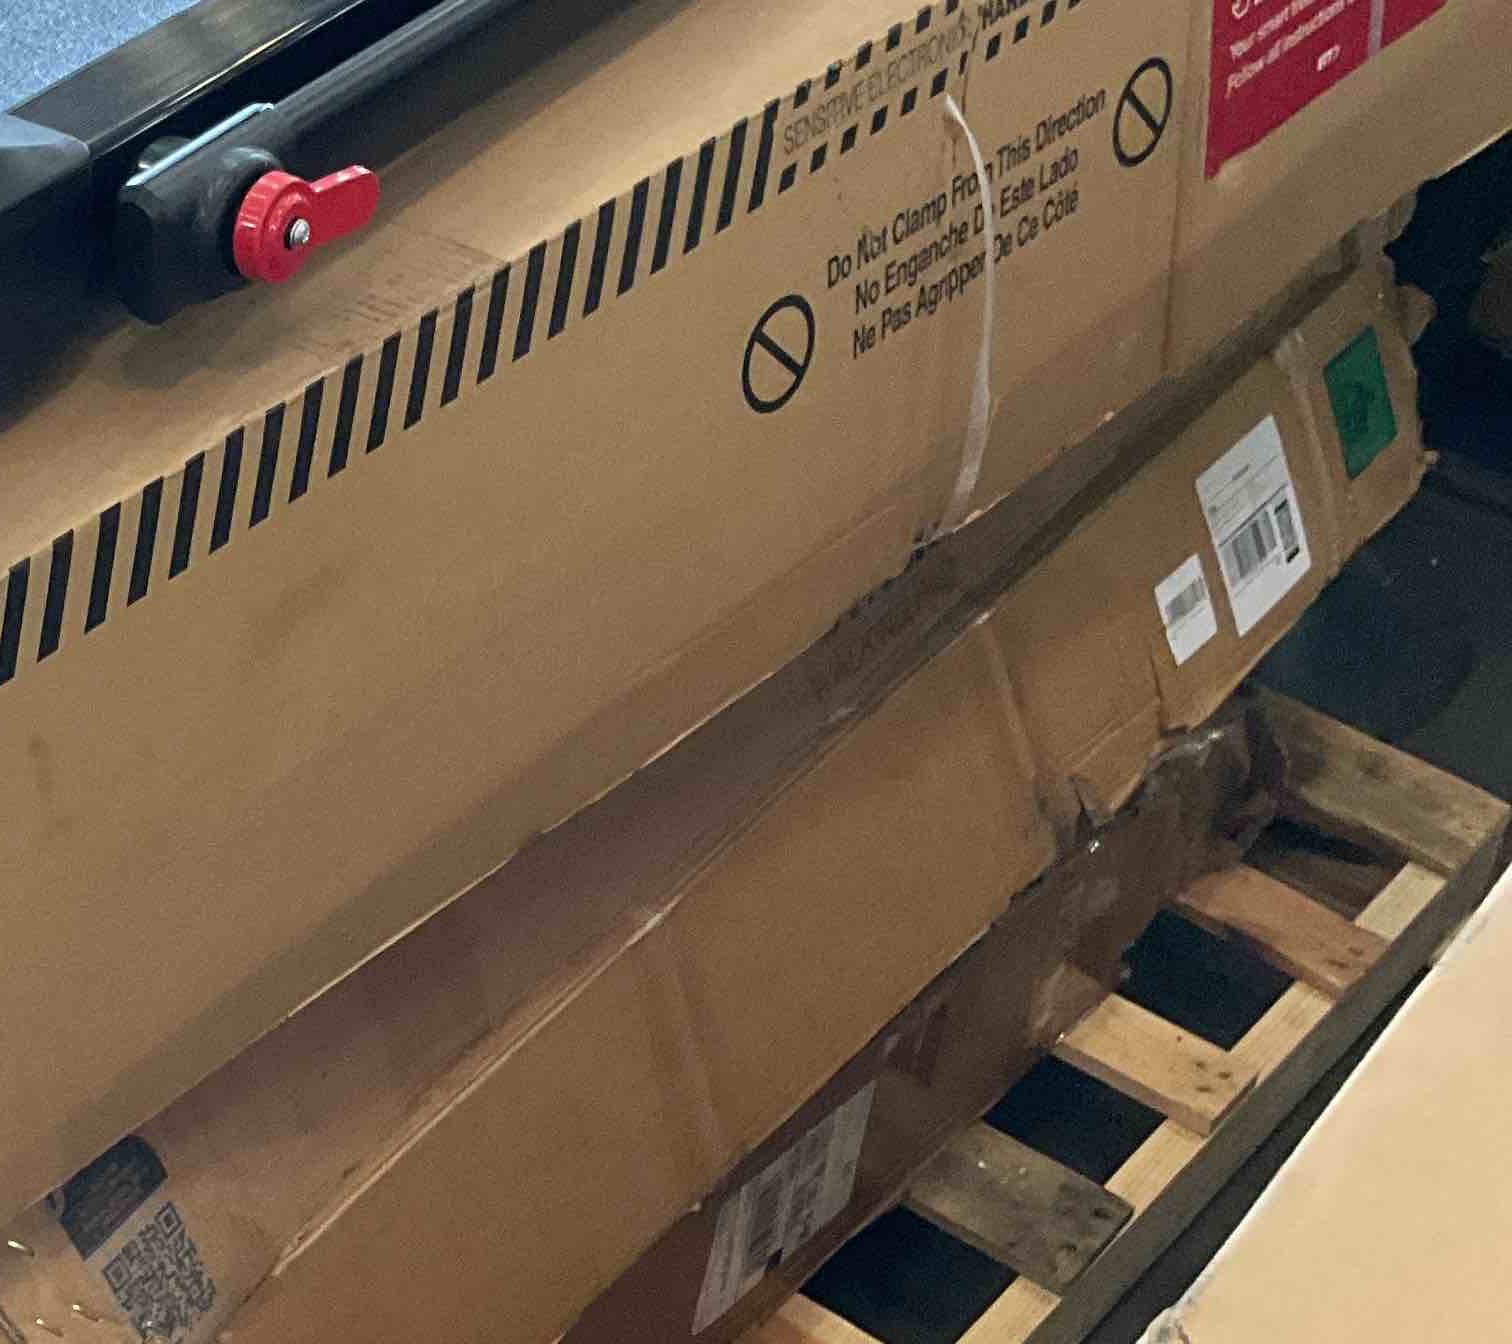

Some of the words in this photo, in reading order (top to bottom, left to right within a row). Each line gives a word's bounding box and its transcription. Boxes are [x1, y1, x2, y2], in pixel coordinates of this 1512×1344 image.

[783, 82, 864, 155] SENSITIVE
[826, 253, 852, 289] Do
[856, 225, 889, 271] Not
[891, 191, 948, 246] Clamp
[996, 135, 1032, 178] This
[1035, 87, 1107, 154] Direction
[852, 322, 877, 361] Ne
[880, 298, 912, 341] Pas
[914, 248, 987, 319] Agripper
[992, 231, 1014, 265] De
[1016, 215, 1039, 248] Ce
[1041, 180, 1081, 233] Côté
[854, 278, 881, 316] No
[883, 219, 969, 297] Enganche
[973, 201, 996, 236] D
[998, 176, 1036, 220] Este
[1038, 146, 1080, 193] Lado
